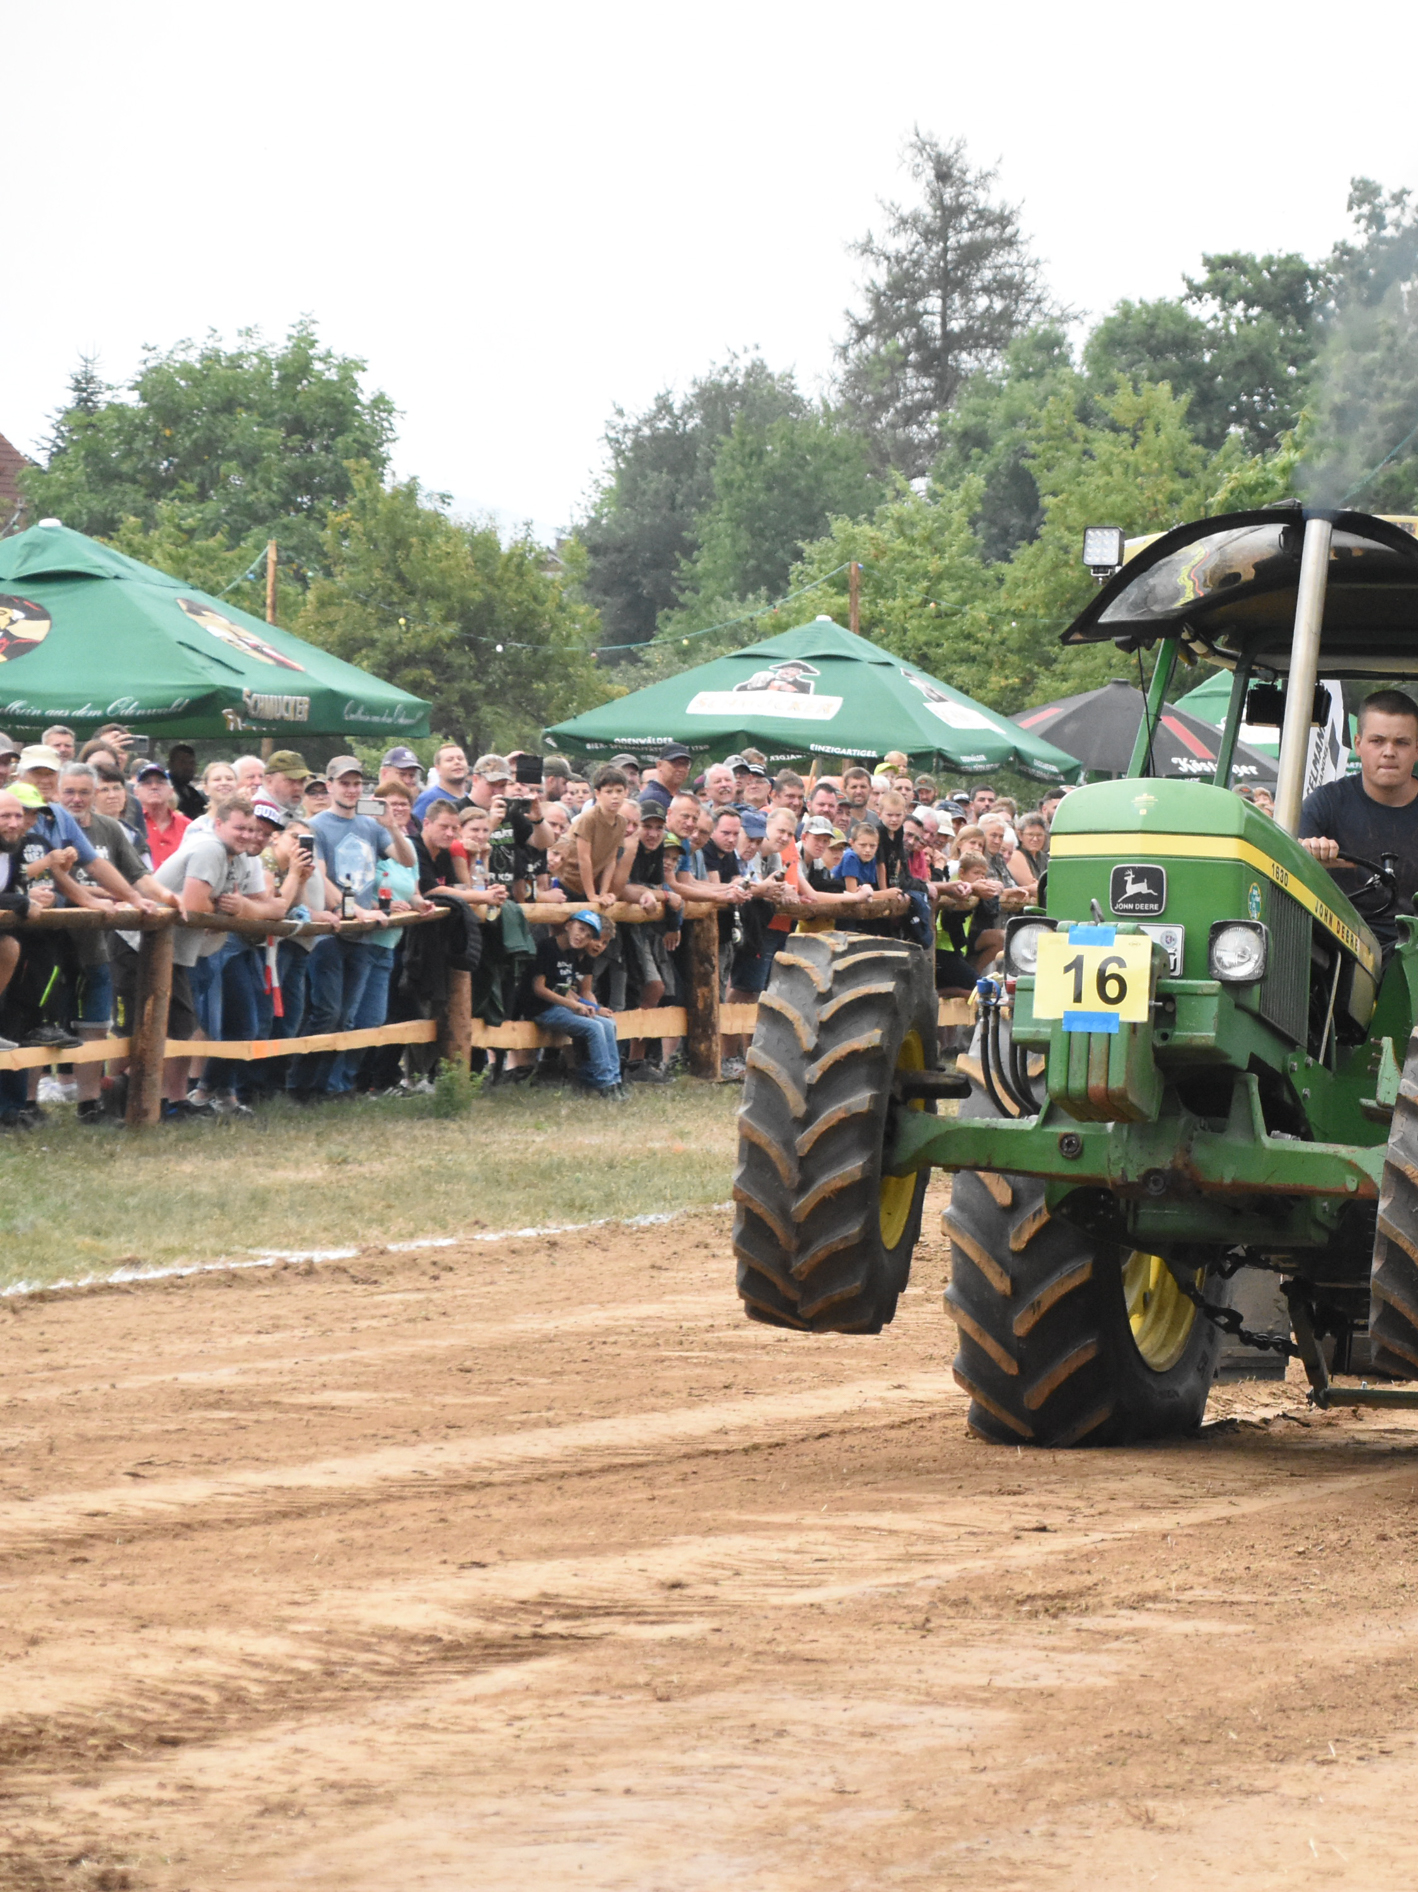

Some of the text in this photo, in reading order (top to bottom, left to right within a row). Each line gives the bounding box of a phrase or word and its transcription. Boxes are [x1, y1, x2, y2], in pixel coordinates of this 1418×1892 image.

[1114, 902, 1159, 911] JOHN DEERE
[1315, 899, 1360, 952] JOHN DEERE
[1062, 954, 1128, 1006] 16
